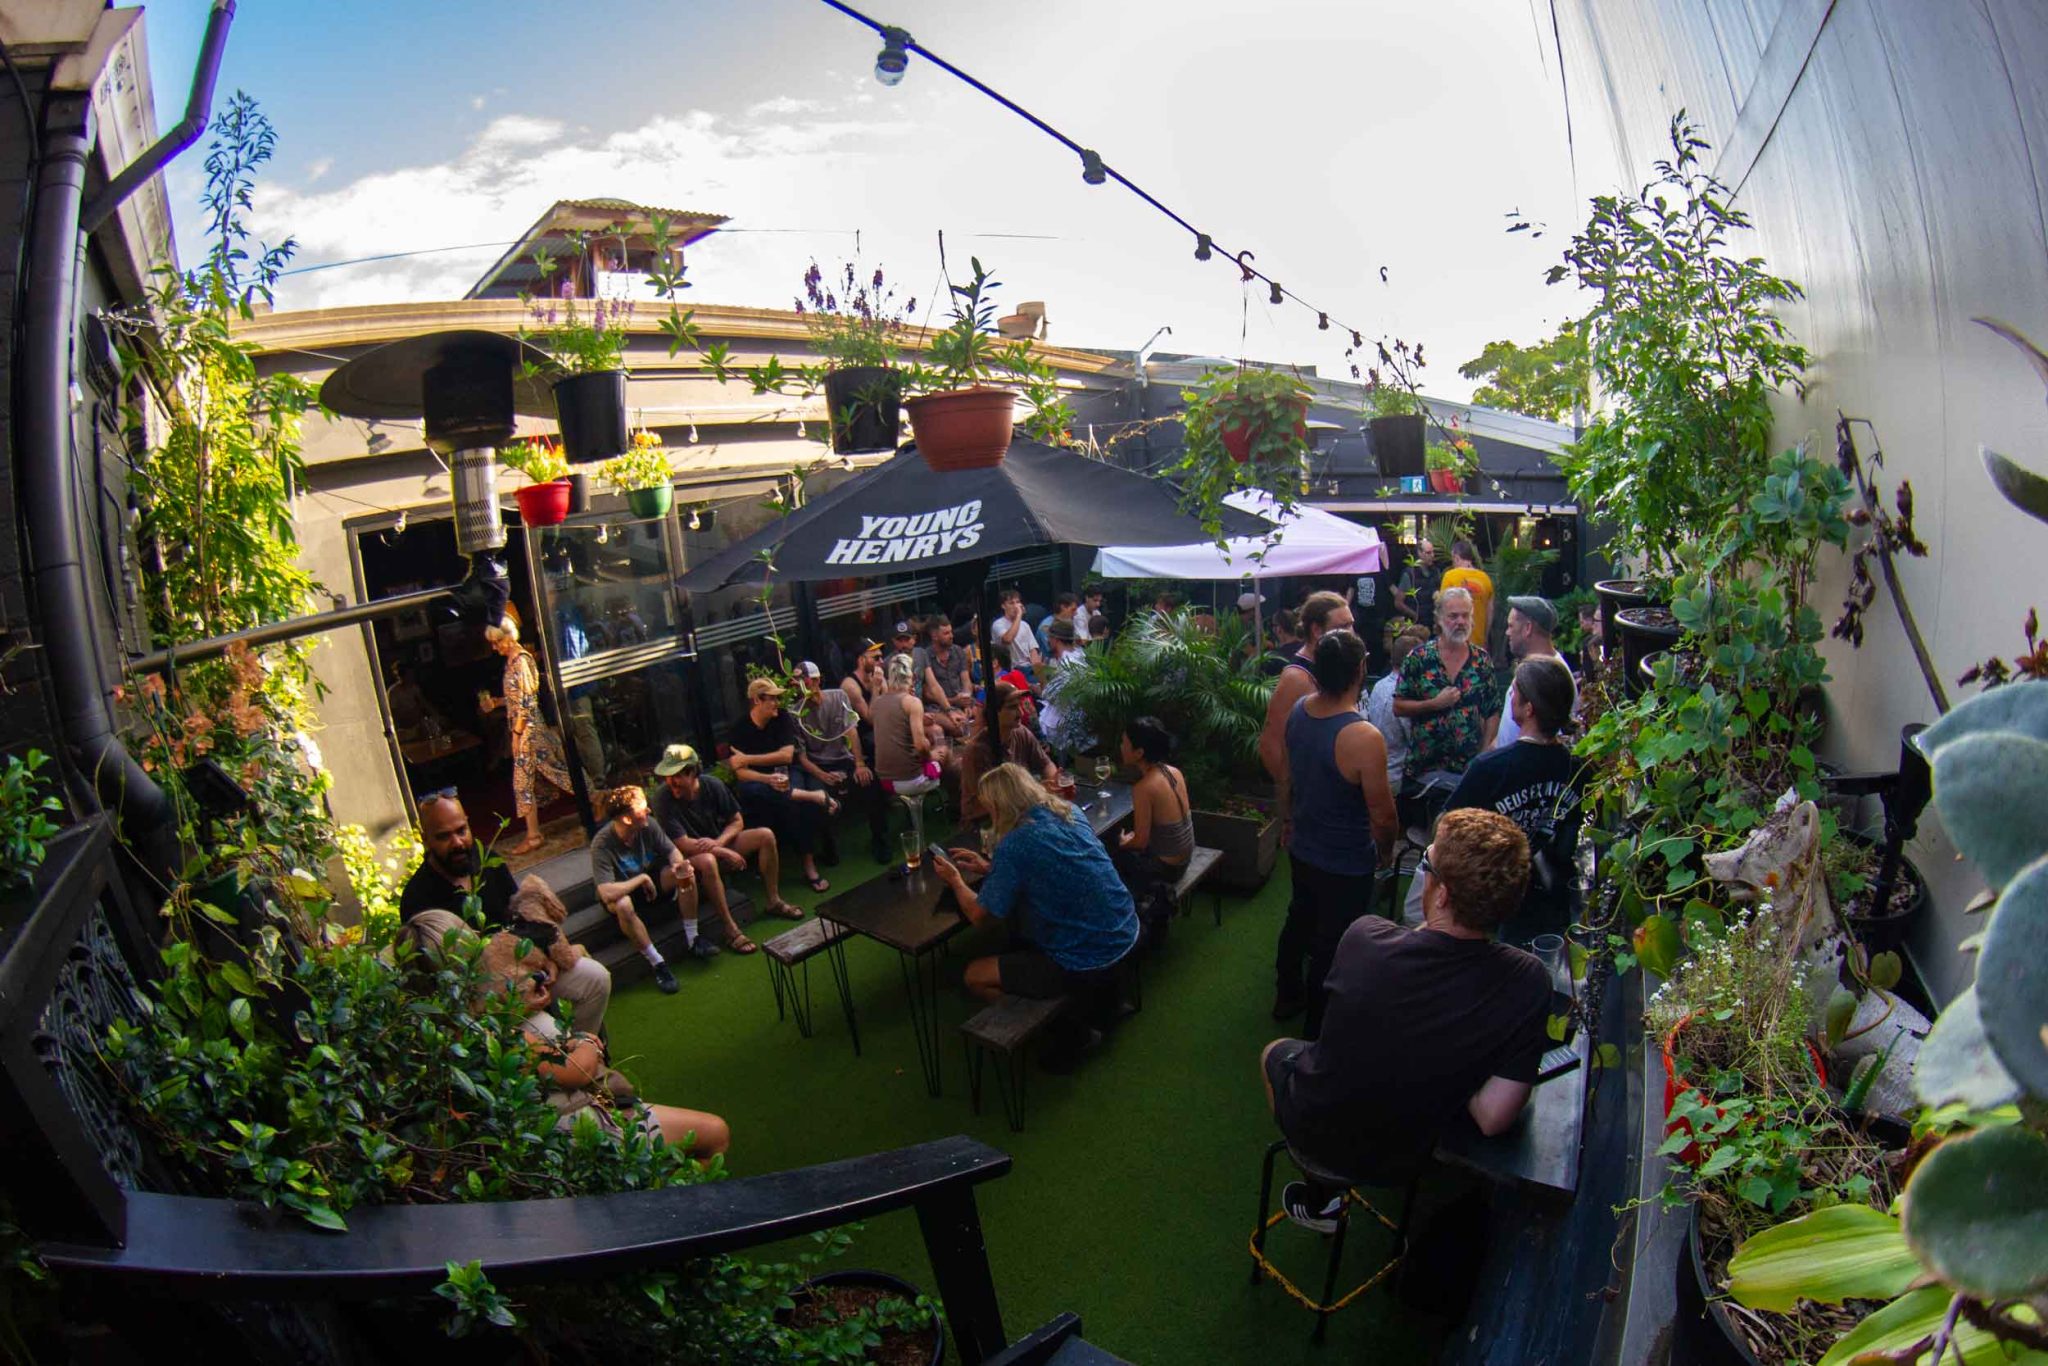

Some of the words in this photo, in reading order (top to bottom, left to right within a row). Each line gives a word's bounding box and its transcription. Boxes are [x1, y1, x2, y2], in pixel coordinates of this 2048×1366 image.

[857, 500, 983, 539] YOUNG
[824, 522, 985, 564] HENRYS
[1495, 788, 1529, 815] DEUS
